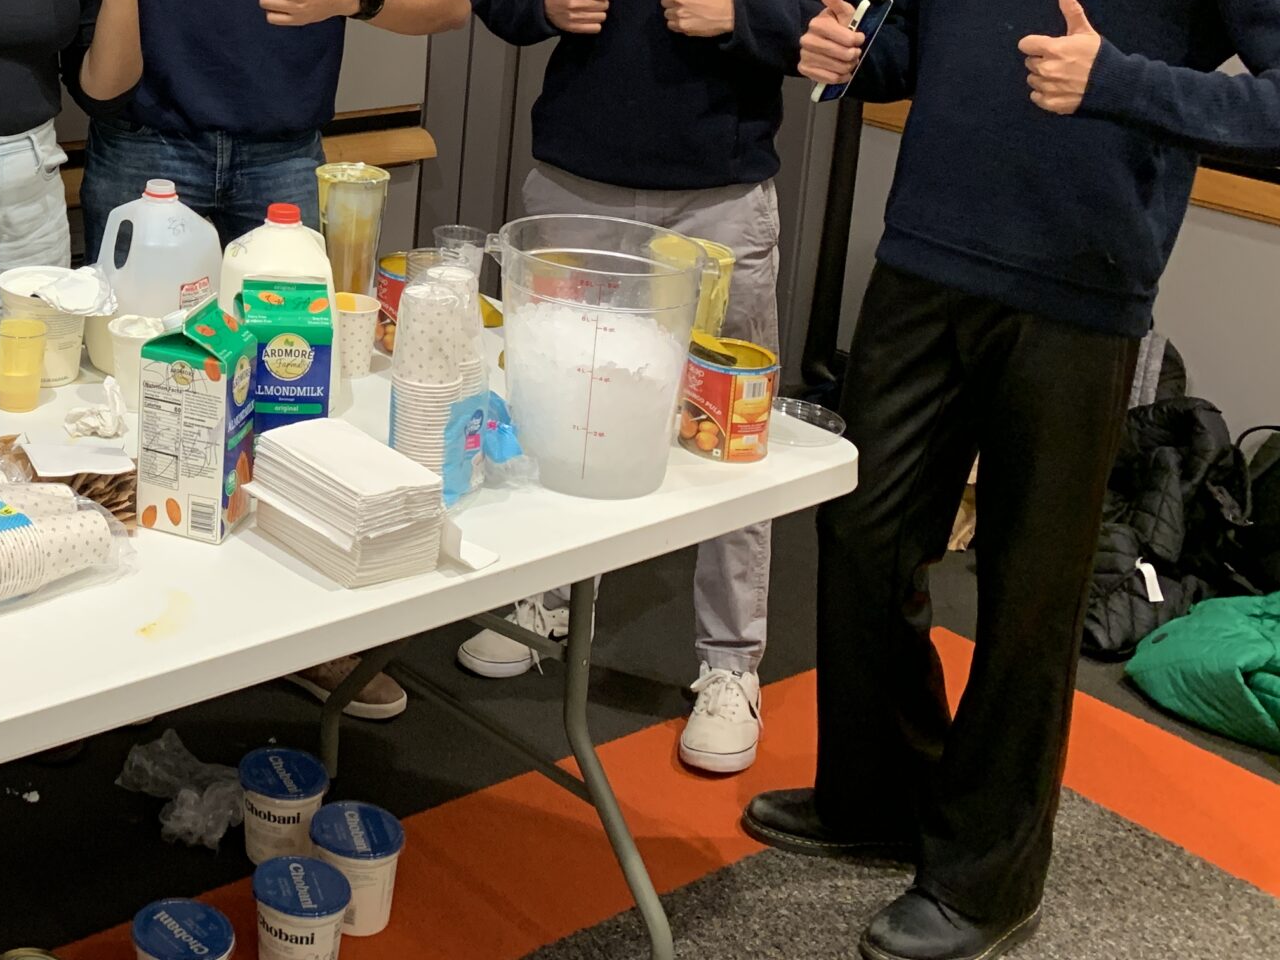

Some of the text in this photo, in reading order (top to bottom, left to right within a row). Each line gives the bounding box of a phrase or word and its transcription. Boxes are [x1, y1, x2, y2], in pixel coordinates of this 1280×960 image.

[263, 348, 313, 360] ARDMORE
[255, 385, 324, 396] LMONDMILK
[275, 403, 299, 413] original
[704, 400, 722, 416] PULP
[269, 755, 303, 794] Chobani
[245, 797, 301, 825] Chobani
[344, 810, 371, 853] Chobani
[288, 862, 318, 910] Chobani
[152, 909, 209, 956] Chobani
